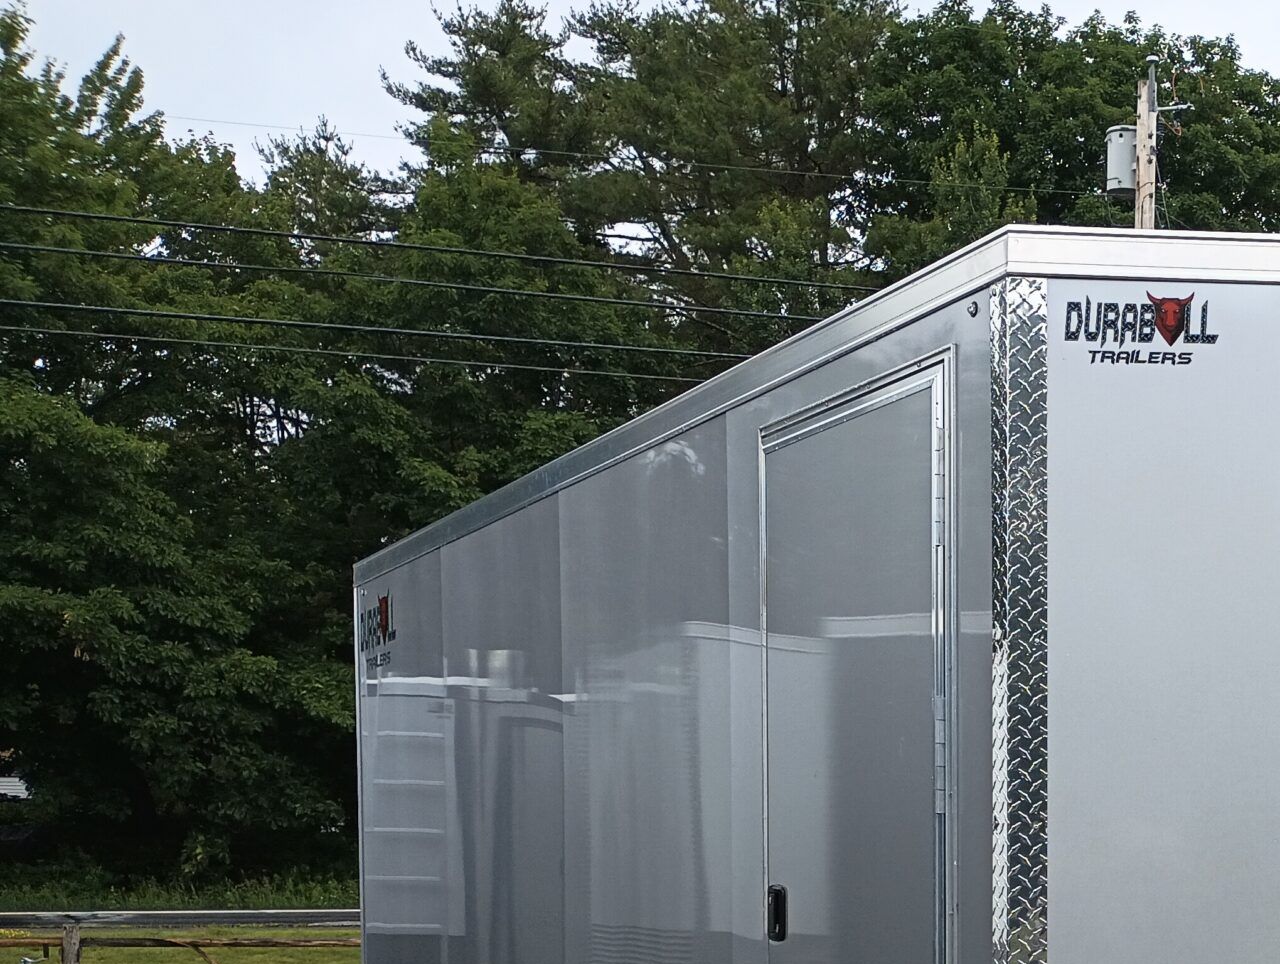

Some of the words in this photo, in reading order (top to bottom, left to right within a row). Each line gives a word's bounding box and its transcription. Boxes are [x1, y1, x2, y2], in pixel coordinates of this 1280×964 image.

[1064, 294, 1219, 349] DURABLL
[1088, 350, 1193, 365] TRAILERS
[361, 594, 396, 653] DURABLL
